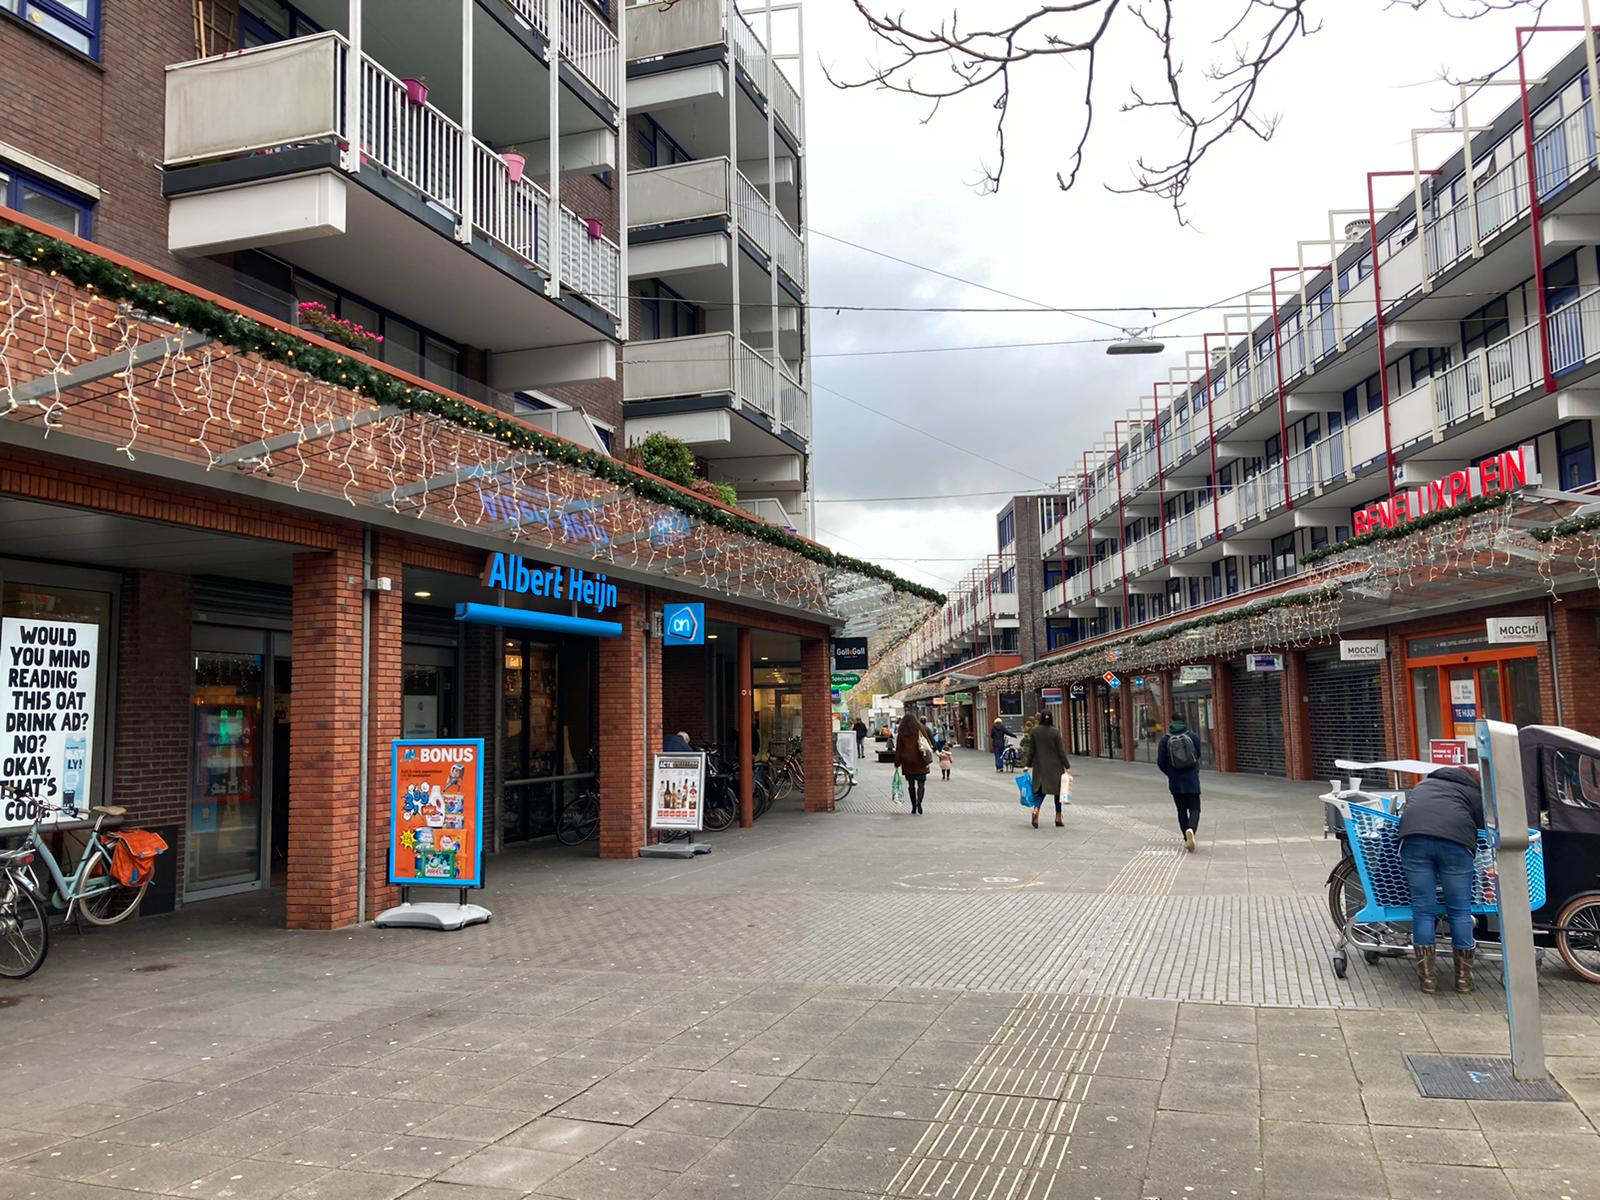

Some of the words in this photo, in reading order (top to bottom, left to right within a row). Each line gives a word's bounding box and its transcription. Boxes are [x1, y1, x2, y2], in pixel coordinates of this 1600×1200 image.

[487, 552, 564, 599] Albert
[568, 567, 618, 613] Heijn
[20, 625, 77, 647] WOULD
[10, 646, 44, 667] YOU
[49, 649, 90, 669] MIND
[8, 668, 78, 689] READING
[12, 691, 51, 710] THIS
[56, 691, 86, 710] OAT
[6, 713, 57, 732] DRINK
[61, 712, 89, 731] AD?
[13, 735, 47, 754] NO?
[420, 748, 474, 763] BONUS
[3, 756, 51, 777] OKAY,
